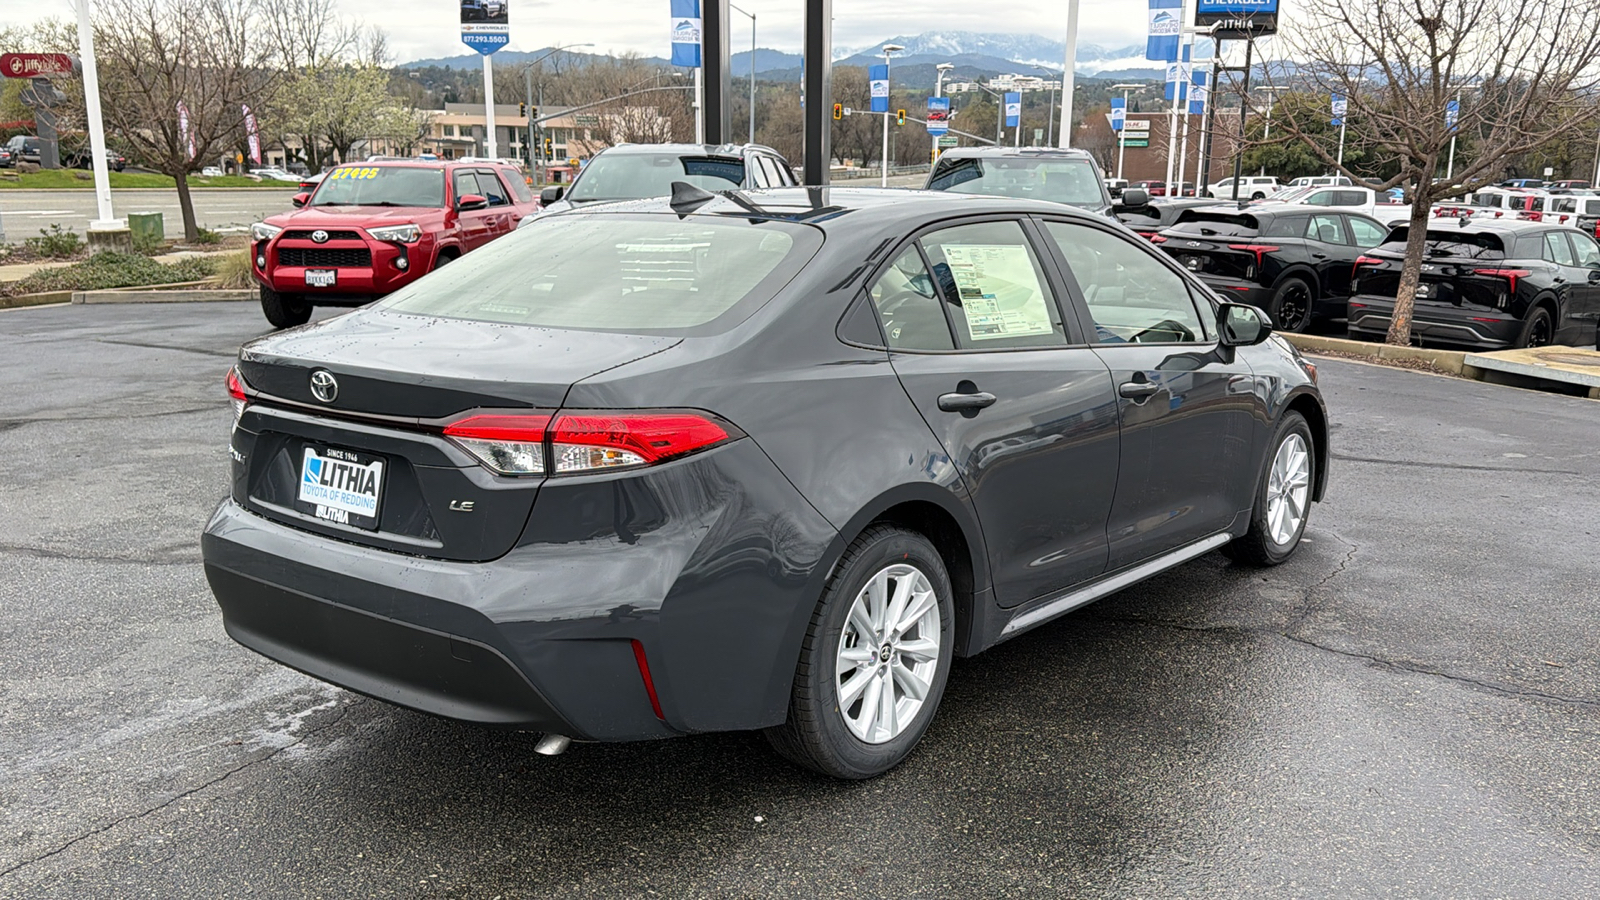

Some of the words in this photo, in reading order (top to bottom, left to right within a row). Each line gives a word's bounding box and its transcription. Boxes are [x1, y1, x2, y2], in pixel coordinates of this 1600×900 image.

[463, 35, 507, 43] 877.293.5503
[331, 167, 380, 180] 27495
[327, 448, 343, 459] SINCE
[344, 452, 358, 462] 1946
[319, 460, 376, 497] LITHIA
[303, 483, 328, 499] TOYOTA
[329, 489, 341, 500] OF
[340, 492, 376, 510] REDDING
[449, 500, 475, 511] LE
[324, 506, 349, 524] LITHIA
